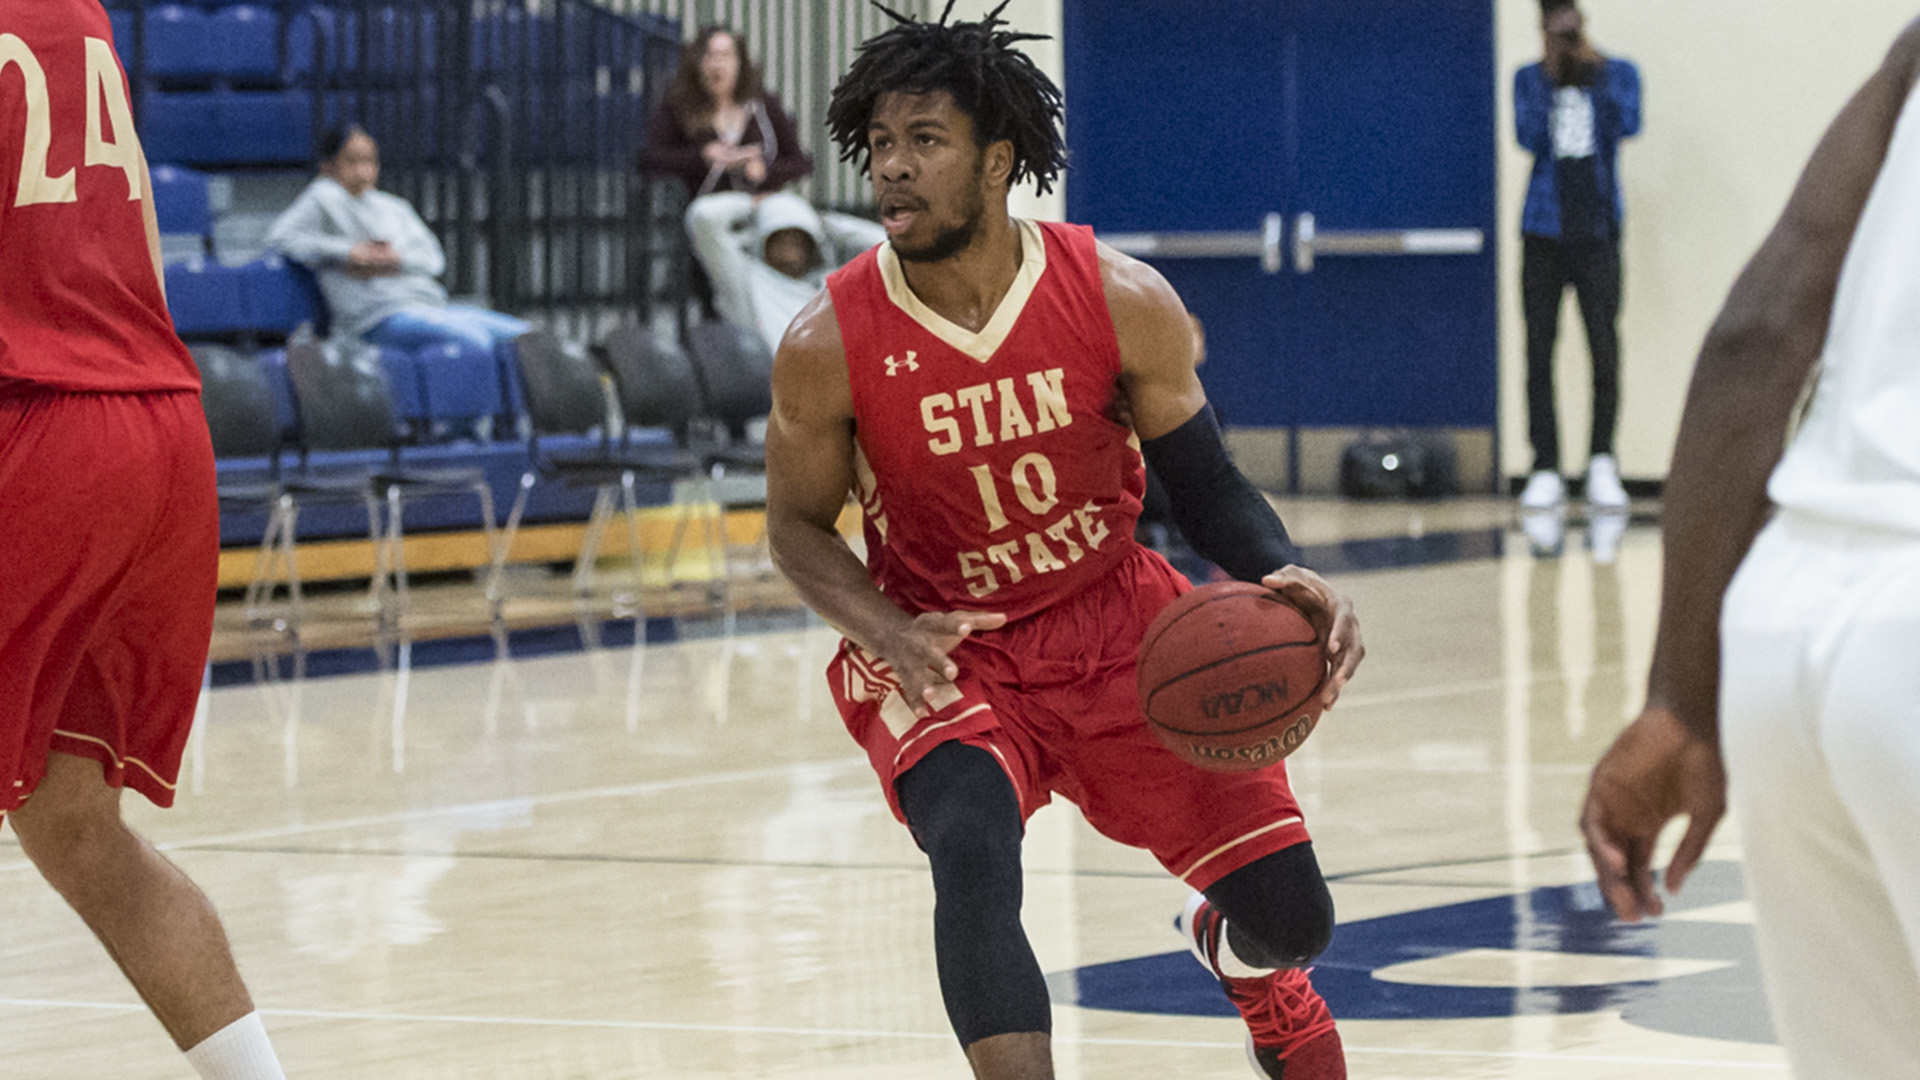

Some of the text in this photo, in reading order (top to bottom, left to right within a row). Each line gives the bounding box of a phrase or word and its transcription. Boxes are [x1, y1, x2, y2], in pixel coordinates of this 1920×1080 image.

[0, 33, 142, 208] 24
[920, 368, 1073, 456] STAN
[968, 452, 1059, 533] 10
[957, 499, 1110, 598] STATE
[1202, 677, 1289, 718] NCAA
